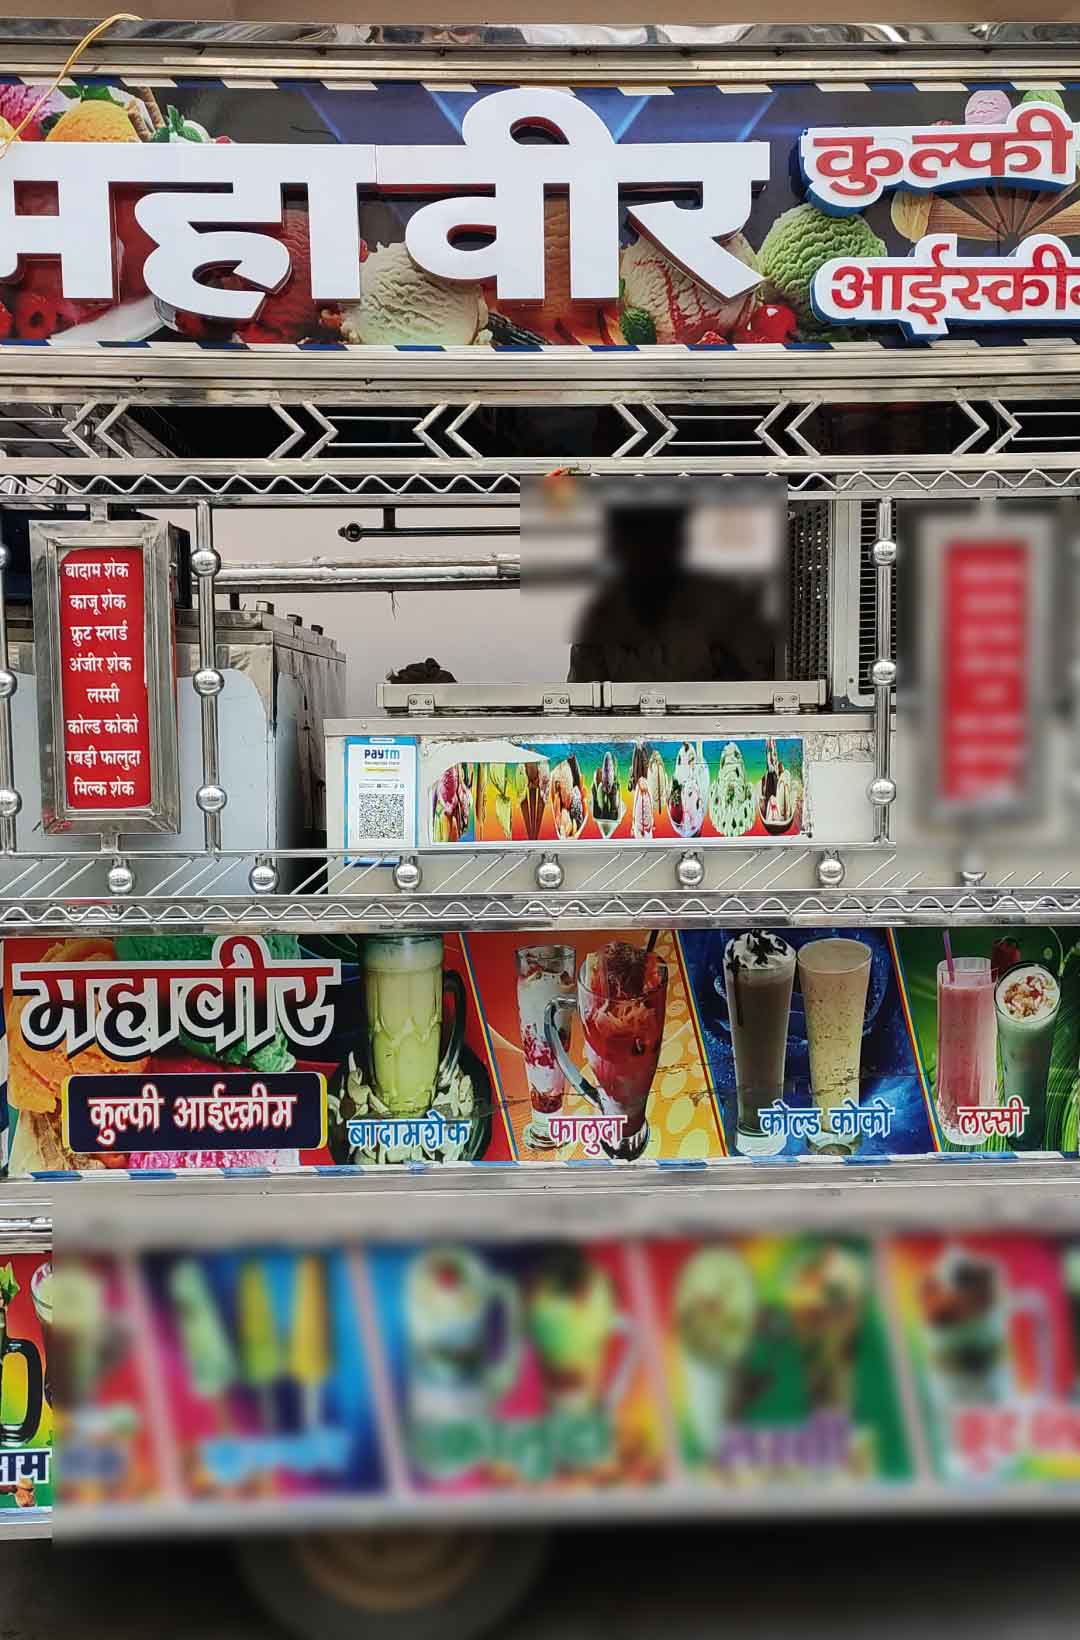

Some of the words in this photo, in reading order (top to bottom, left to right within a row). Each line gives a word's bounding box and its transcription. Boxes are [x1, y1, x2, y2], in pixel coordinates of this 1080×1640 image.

[812, 108, 1074, 196] कुल्फी
[0, 88, 770, 318] महावीर
[64, 562, 101, 580] बादाम
[103, 557, 129, 579] शेक
[69, 594, 101, 615] काजू
[101, 588, 126, 610] शेक
[70, 626, 92, 647] फ्रुट
[69, 652, 104, 672] अंजीर
[106, 651, 132, 673] शेक
[86, 682, 120, 703] लस्सी
[66, 713, 101, 734] कोल्ड
[103, 713, 139, 734] कोको
[100, 750, 141, 770] फालुदा
[73, 776, 107, 796] मिल्क
[109, 775, 135, 797] शेक
[13, 935, 341, 1058] महावीर
[87, 1083, 165, 1146] कुल्फी
[173, 1082, 298, 1132] आईस्क्रीम
[757, 1098, 822, 1138] कोल्ड
[828, 1097, 895, 1138] कोको
[957, 1094, 1030, 1138] लस्सी
[547, 1114, 627, 1155] फालुदा
